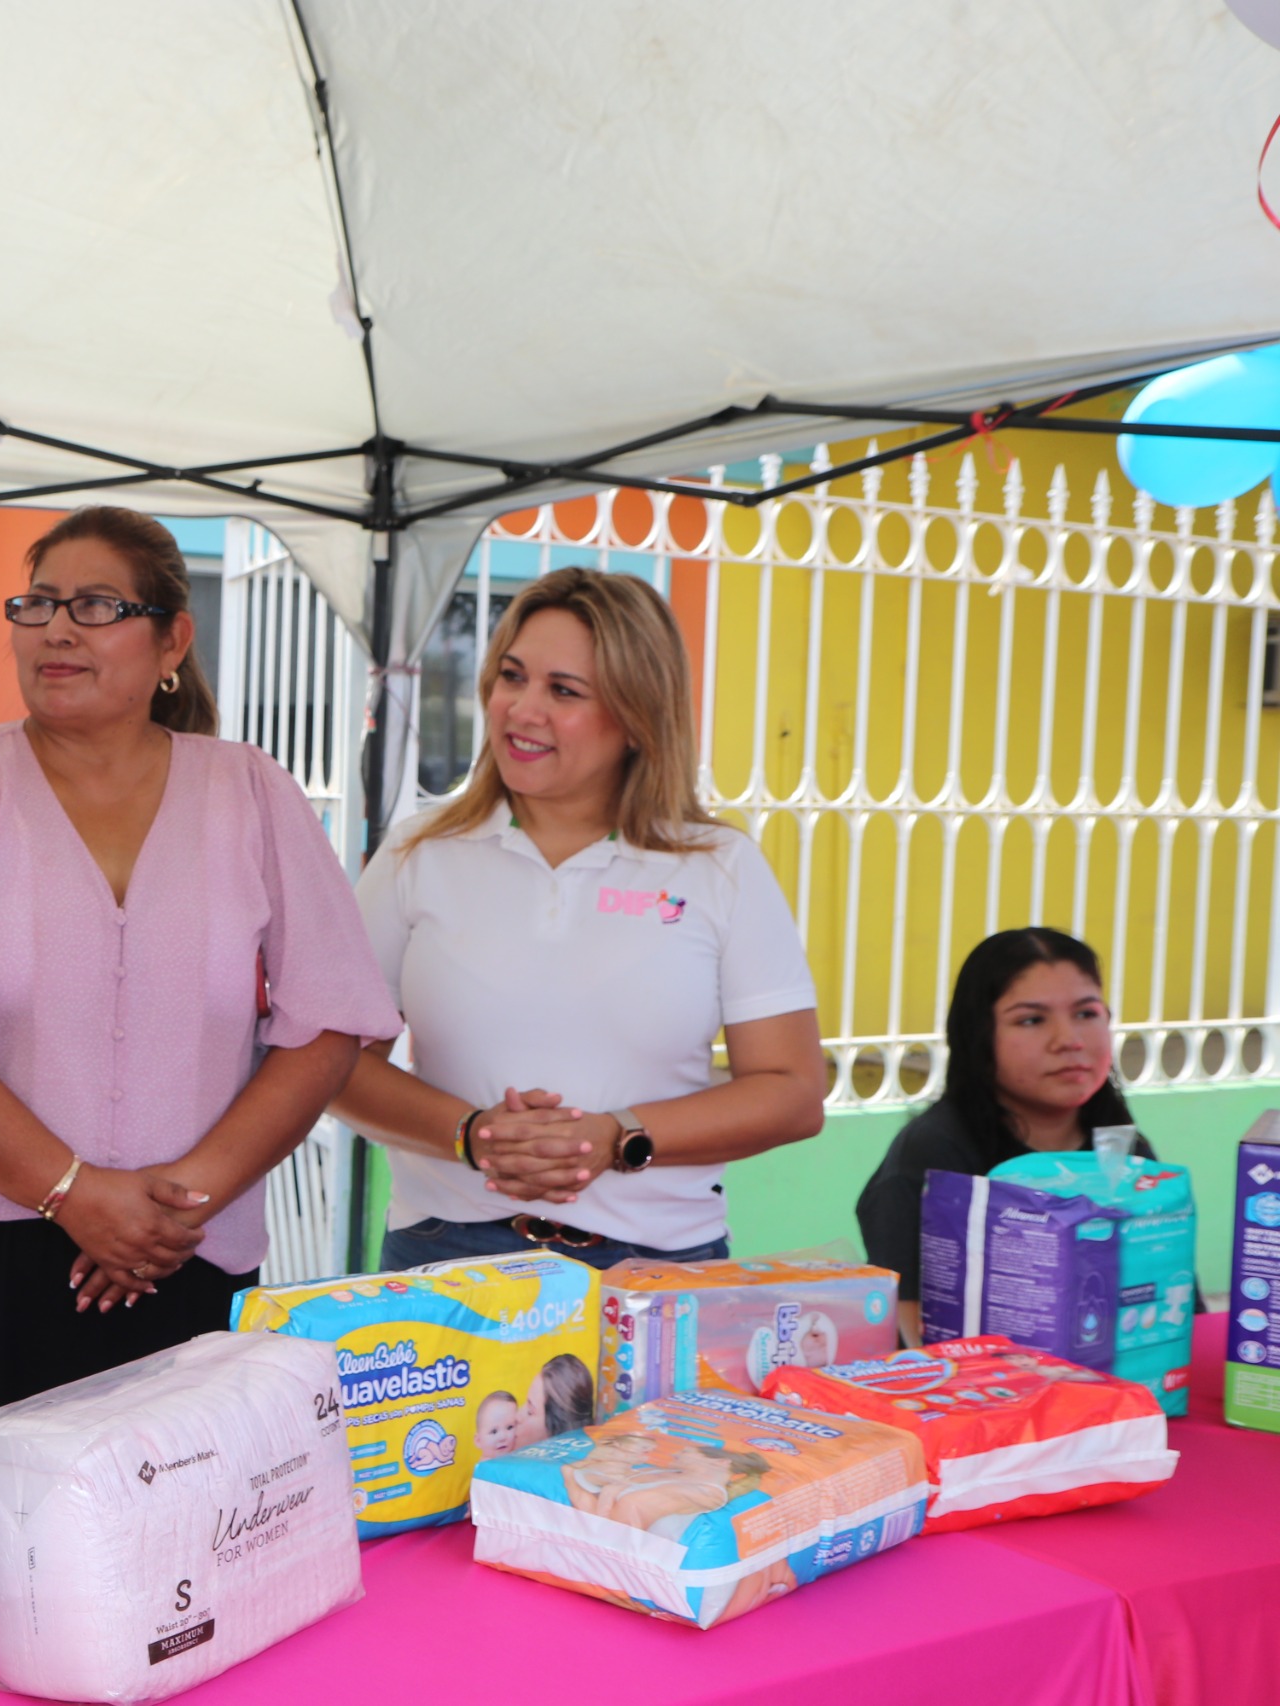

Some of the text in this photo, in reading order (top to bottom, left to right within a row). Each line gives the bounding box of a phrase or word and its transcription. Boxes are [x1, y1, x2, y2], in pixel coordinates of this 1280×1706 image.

[597, 886, 656, 917] DIF
[572, 1298, 585, 1323] 2
[342, 1359, 469, 1407] uavelastic
[314, 1387, 340, 1421] 24
[250, 1454, 308, 1490] TOTAL PROTECTION
[212, 1486, 314, 1551] Underwear
[216, 1521, 289, 1567] FOR WOMEN
[175, 1579, 192, 1612] S
[156, 1620, 179, 1634] Waist
[160, 1626, 204, 1650] MAXIMUM
